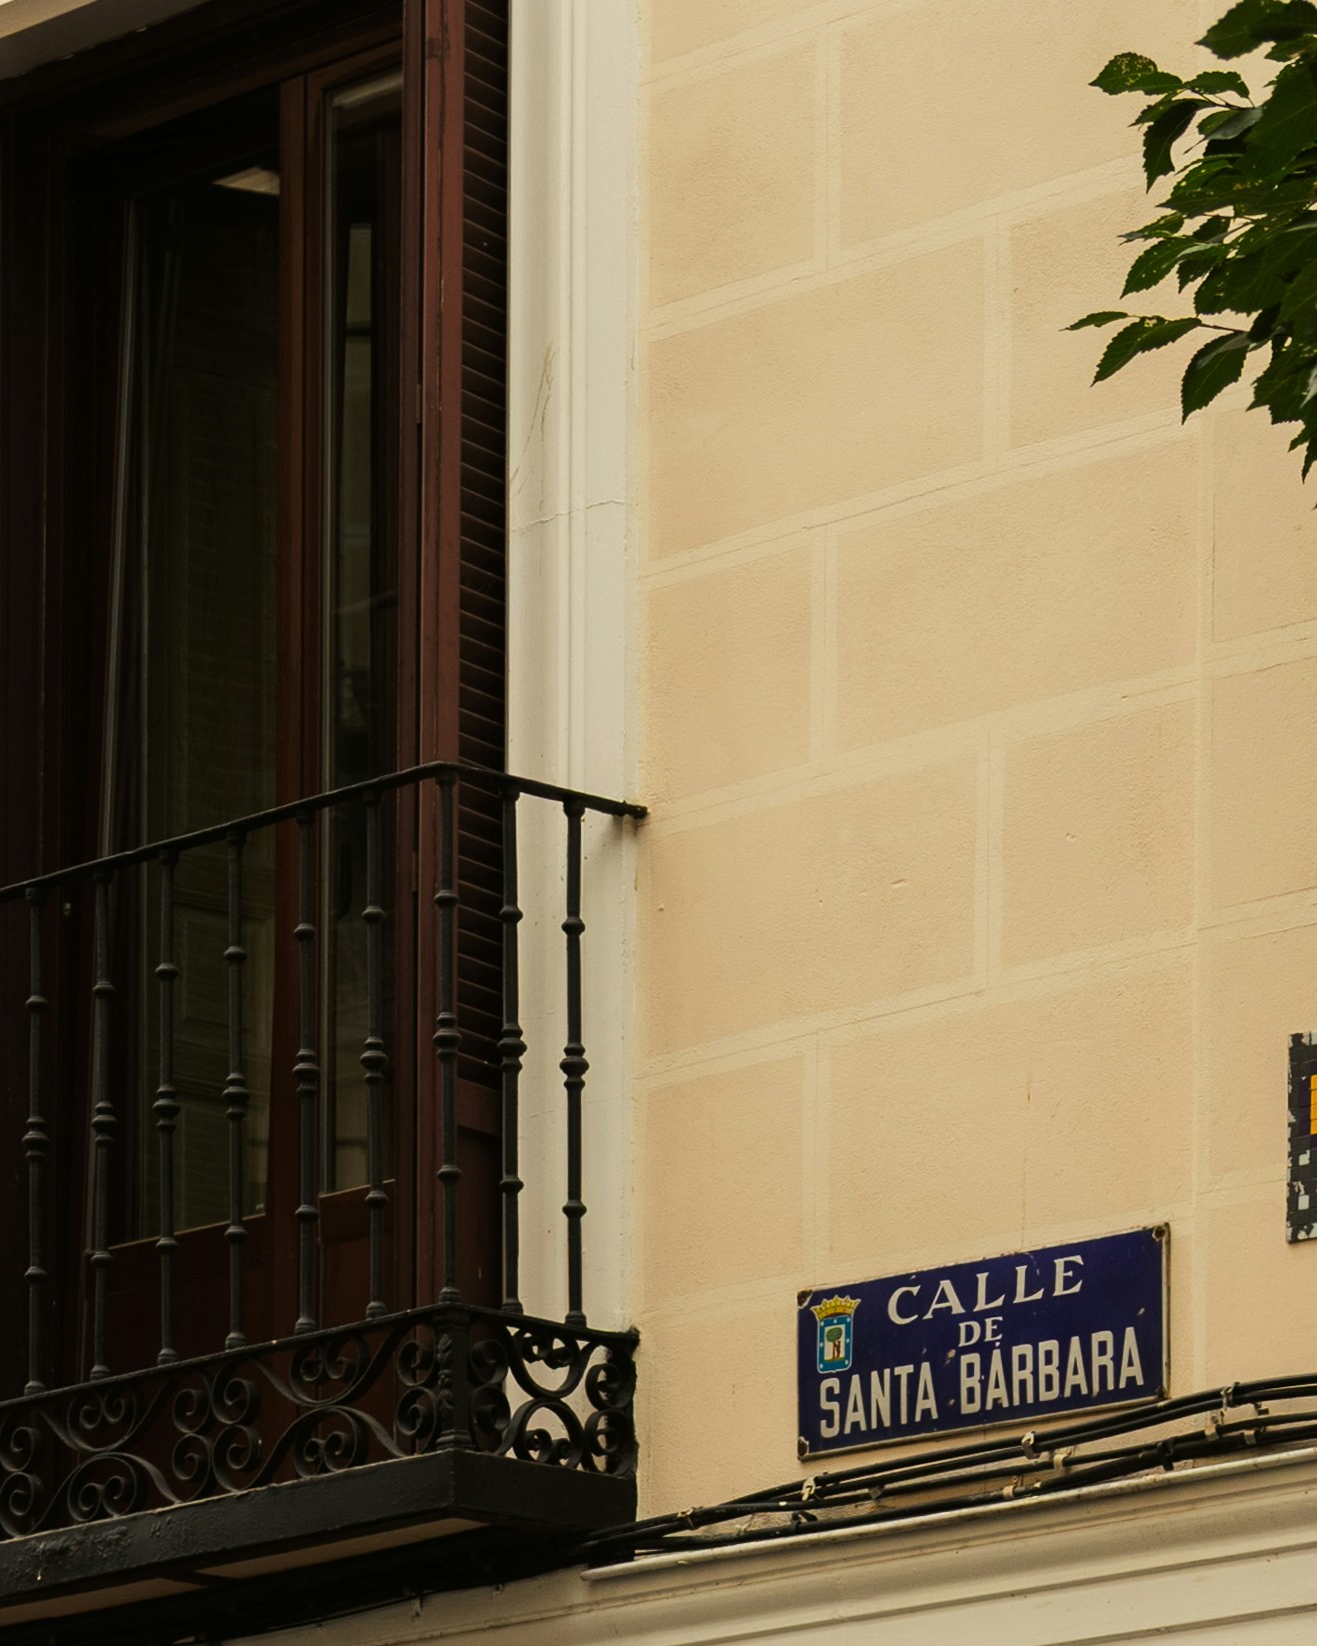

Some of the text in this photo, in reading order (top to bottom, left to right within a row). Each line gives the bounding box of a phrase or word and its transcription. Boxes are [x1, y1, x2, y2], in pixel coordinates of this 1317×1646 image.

[887, 1255, 1084, 1325] CALLE
[958, 1316, 1004, 1347] DE
[819, 1326, 1144, 1438] SANTA BÁRBARA
